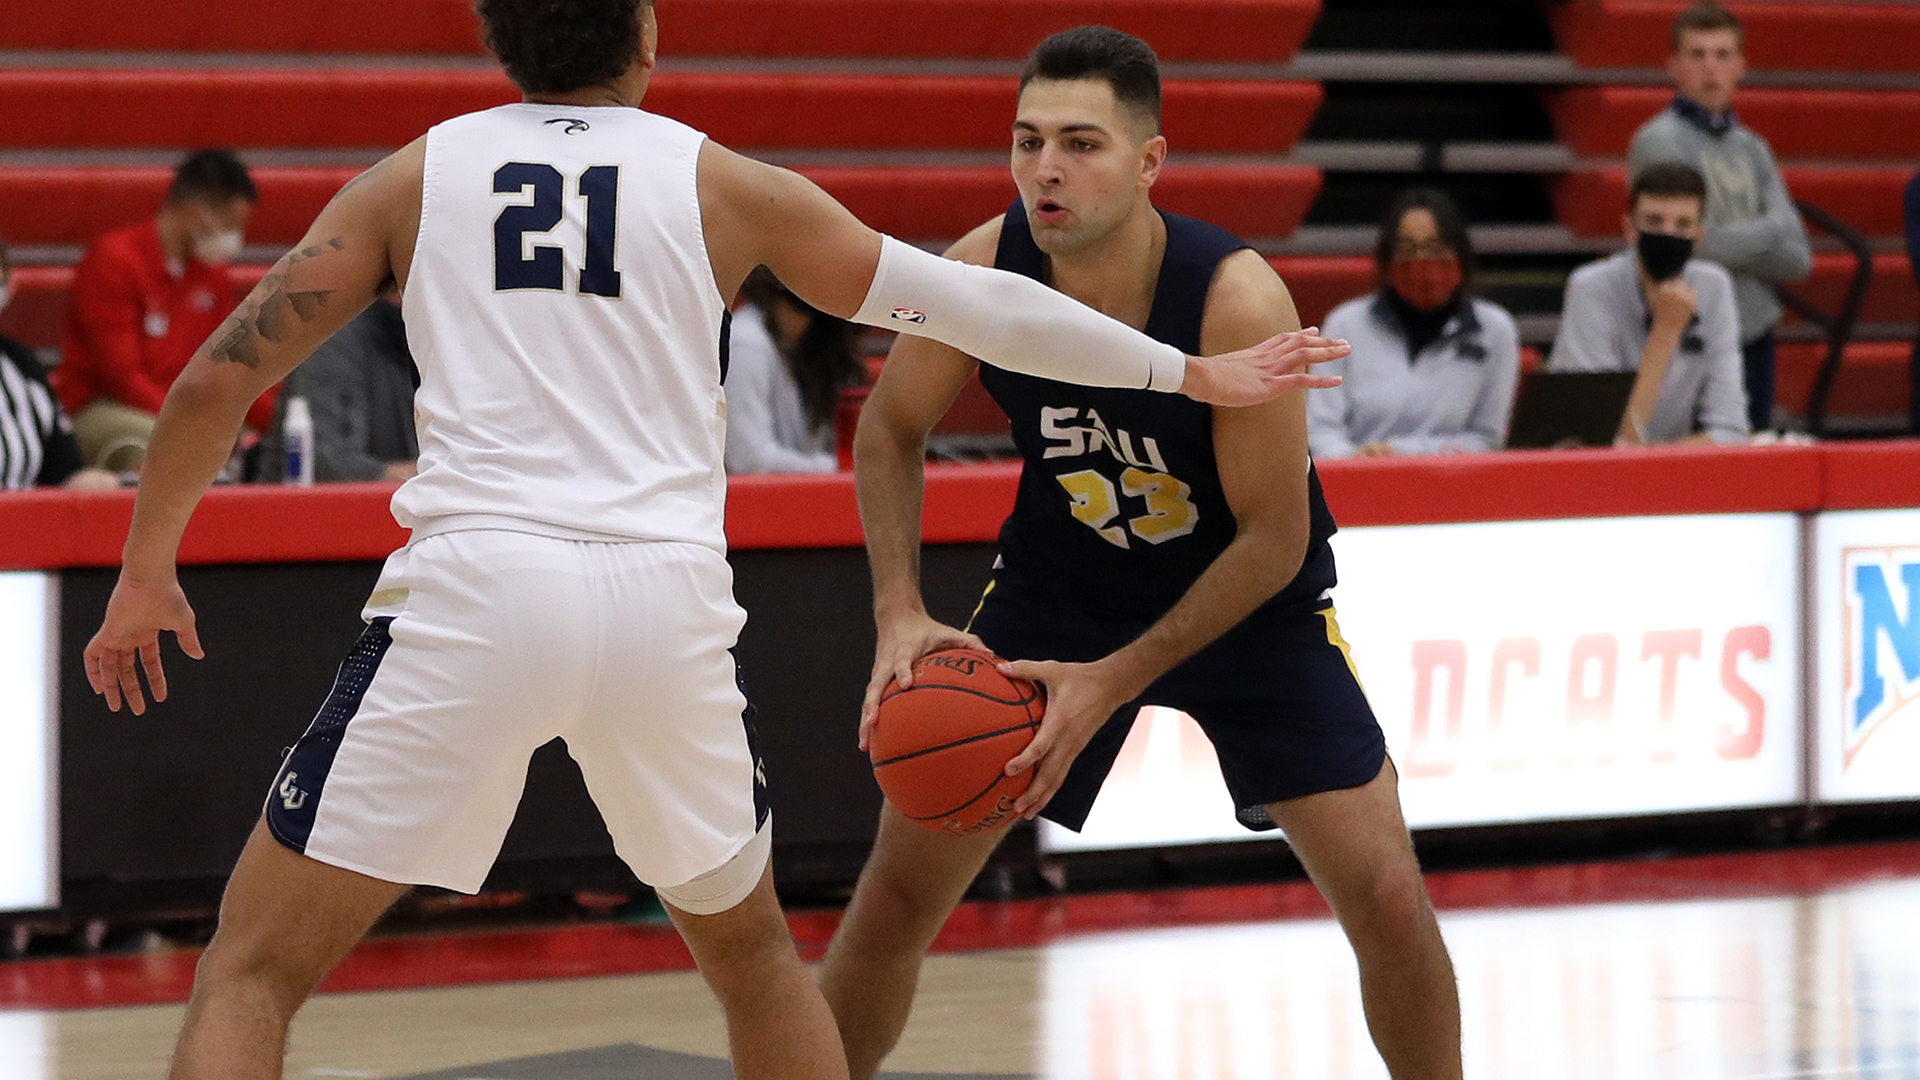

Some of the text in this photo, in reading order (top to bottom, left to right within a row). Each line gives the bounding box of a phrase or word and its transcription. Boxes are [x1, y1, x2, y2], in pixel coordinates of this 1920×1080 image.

[490, 160, 623, 299] 21
[1040, 405, 1169, 473] SAU
[1055, 466, 1200, 550] 23
[1354, 622, 1774, 779] DCATS
[279, 771, 309, 810] CU
